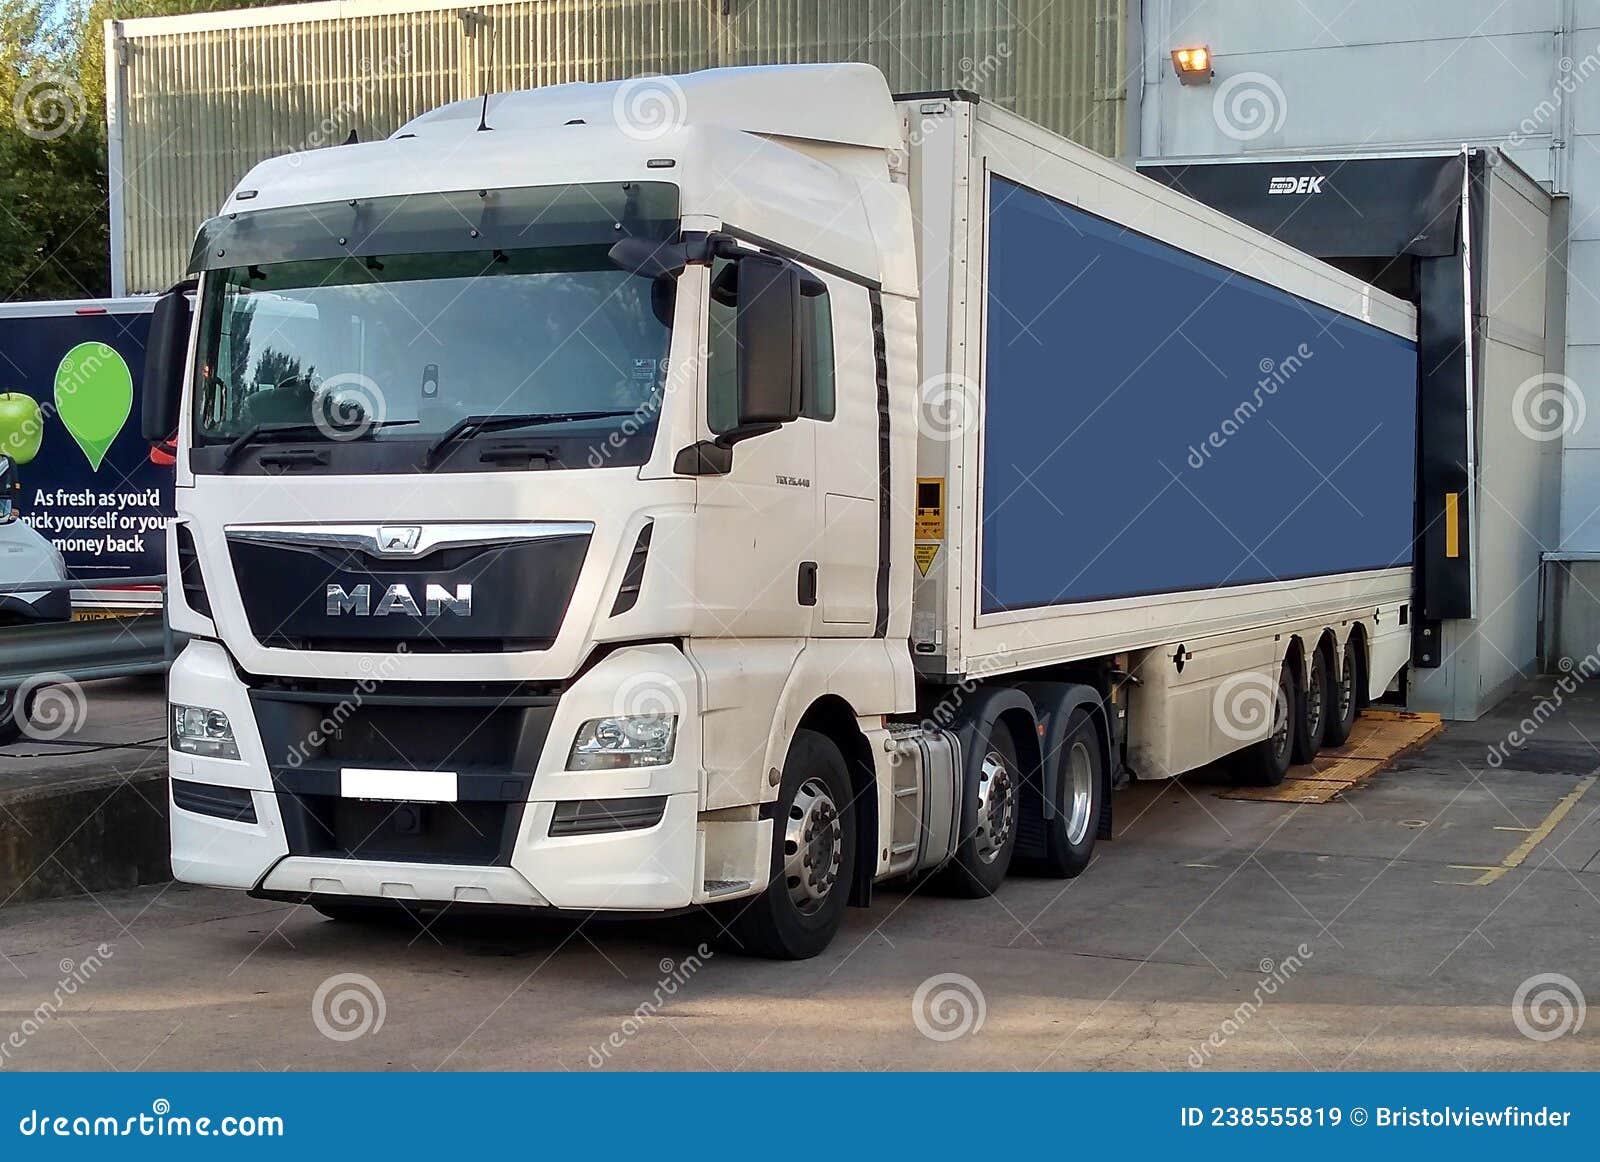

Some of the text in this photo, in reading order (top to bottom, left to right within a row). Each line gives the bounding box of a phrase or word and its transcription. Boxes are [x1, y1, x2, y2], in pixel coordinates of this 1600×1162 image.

[34, 489, 53, 507] As
[56, 489, 95, 507] fresh
[99, 493, 114, 507] as
[22, 513, 53, 529] pick
[55, 512, 118, 533] yourself
[120, 516, 136, 530] or
[51, 535, 145, 556] money back
[326, 584, 472, 616] MAN
